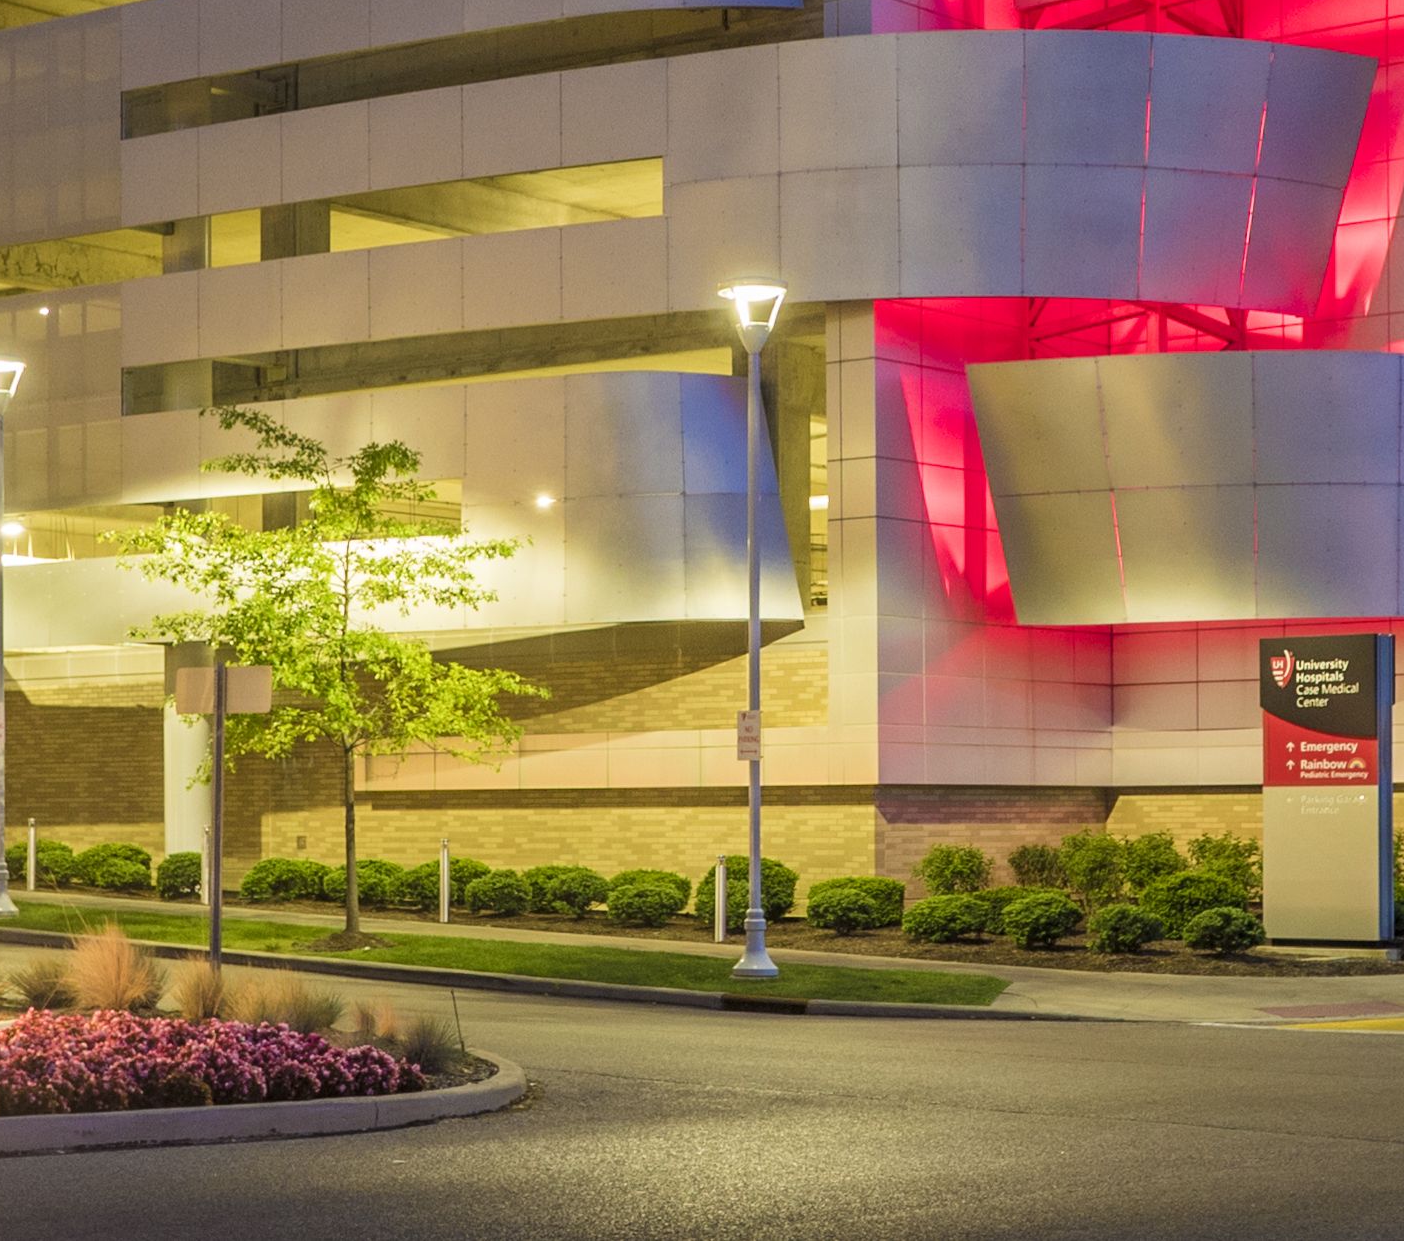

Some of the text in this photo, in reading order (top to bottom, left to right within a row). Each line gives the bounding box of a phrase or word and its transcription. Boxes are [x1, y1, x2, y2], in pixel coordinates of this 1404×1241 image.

[1296, 658, 1349, 671] University
[1296, 671, 1345, 684] Hospitals
[1296, 682, 1359, 695] Case Medical
[1296, 697, 1329, 708] Center
[1300, 742, 1358, 754] Emergency
[1300, 759, 1347, 770] Rainbow
[1331, 770, 1369, 779] Emergency
[1301, 794, 1367, 805] Parking Garae
[1301, 805, 1339, 814] Entrance
